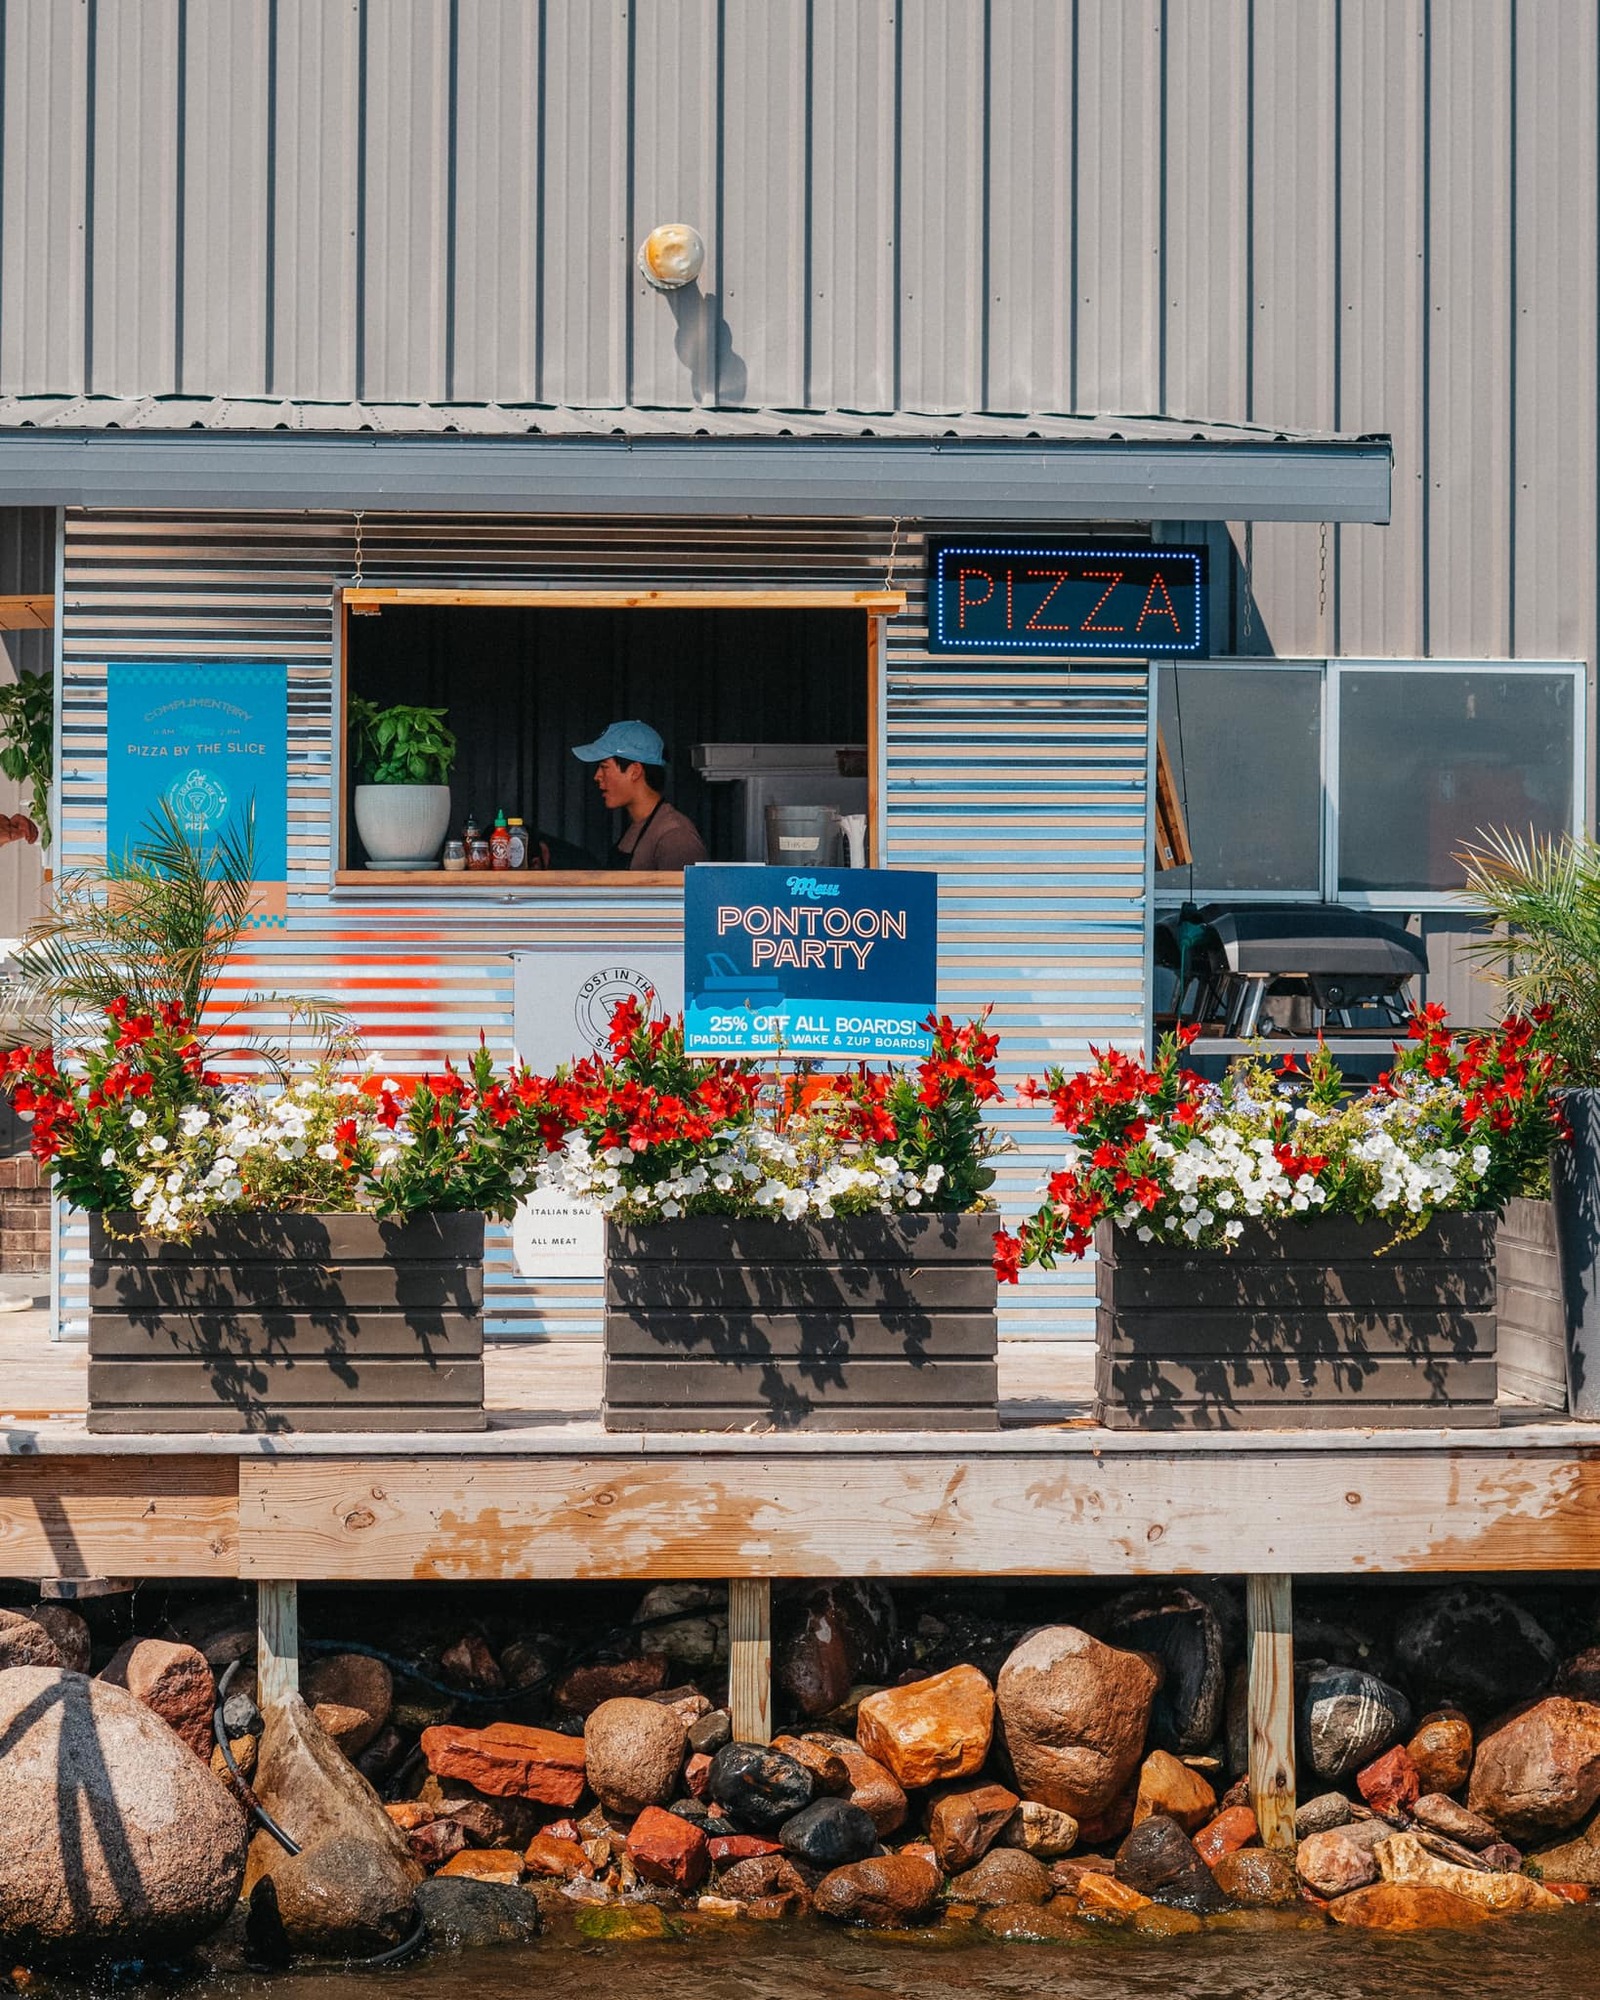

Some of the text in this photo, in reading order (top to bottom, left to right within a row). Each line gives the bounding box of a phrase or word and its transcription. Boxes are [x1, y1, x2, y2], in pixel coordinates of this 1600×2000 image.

[959, 568, 1181, 633] PIZZA
[144, 697, 254, 722] COMPLIMENTARY
[128, 742, 267, 757] PIZZA BY THE SLICE
[718, 905, 907, 940] PONTOON
[752, 938, 875, 970] PARTY
[580, 971, 608, 999] LOST
[614, 969, 629, 980] IN
[710, 1015, 918, 1035] 25% OFF ALL BOARDS!
[793, 1034, 829, 1045] WAKE
[833, 1035, 842, 1045] &
[847, 1035, 871, 1046] ZUP
[531, 1208, 568, 1216] ITALIAN
[531, 1237, 577, 1245] ALL MEAT
